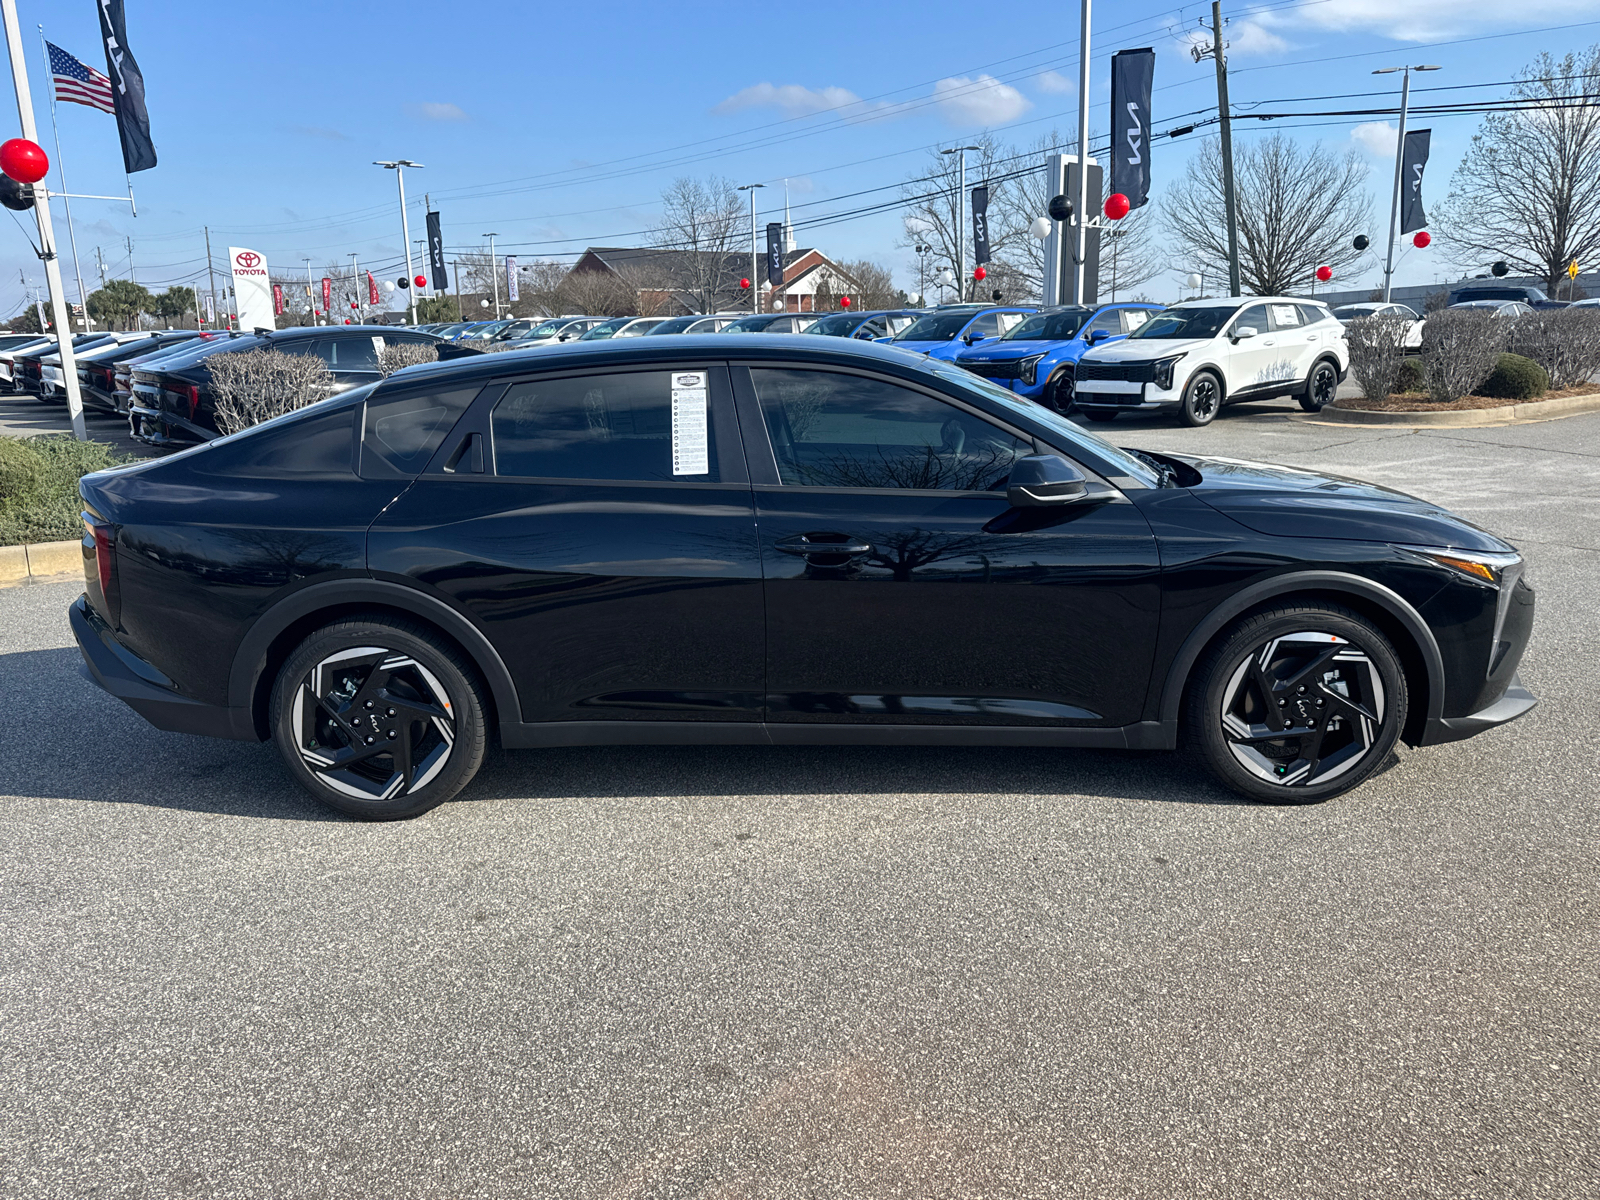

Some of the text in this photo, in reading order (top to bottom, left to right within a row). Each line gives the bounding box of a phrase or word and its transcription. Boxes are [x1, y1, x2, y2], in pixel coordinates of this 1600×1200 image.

[1127, 101, 1141, 165] KIA
[976, 212, 985, 242] KIA
[433, 237, 441, 268] KIA
[233, 268, 267, 276] TOYOTA
[508, 266, 516, 298] TOYOTA
[369, 714, 380, 733] KIA
[1296, 699, 1307, 718] KIA
